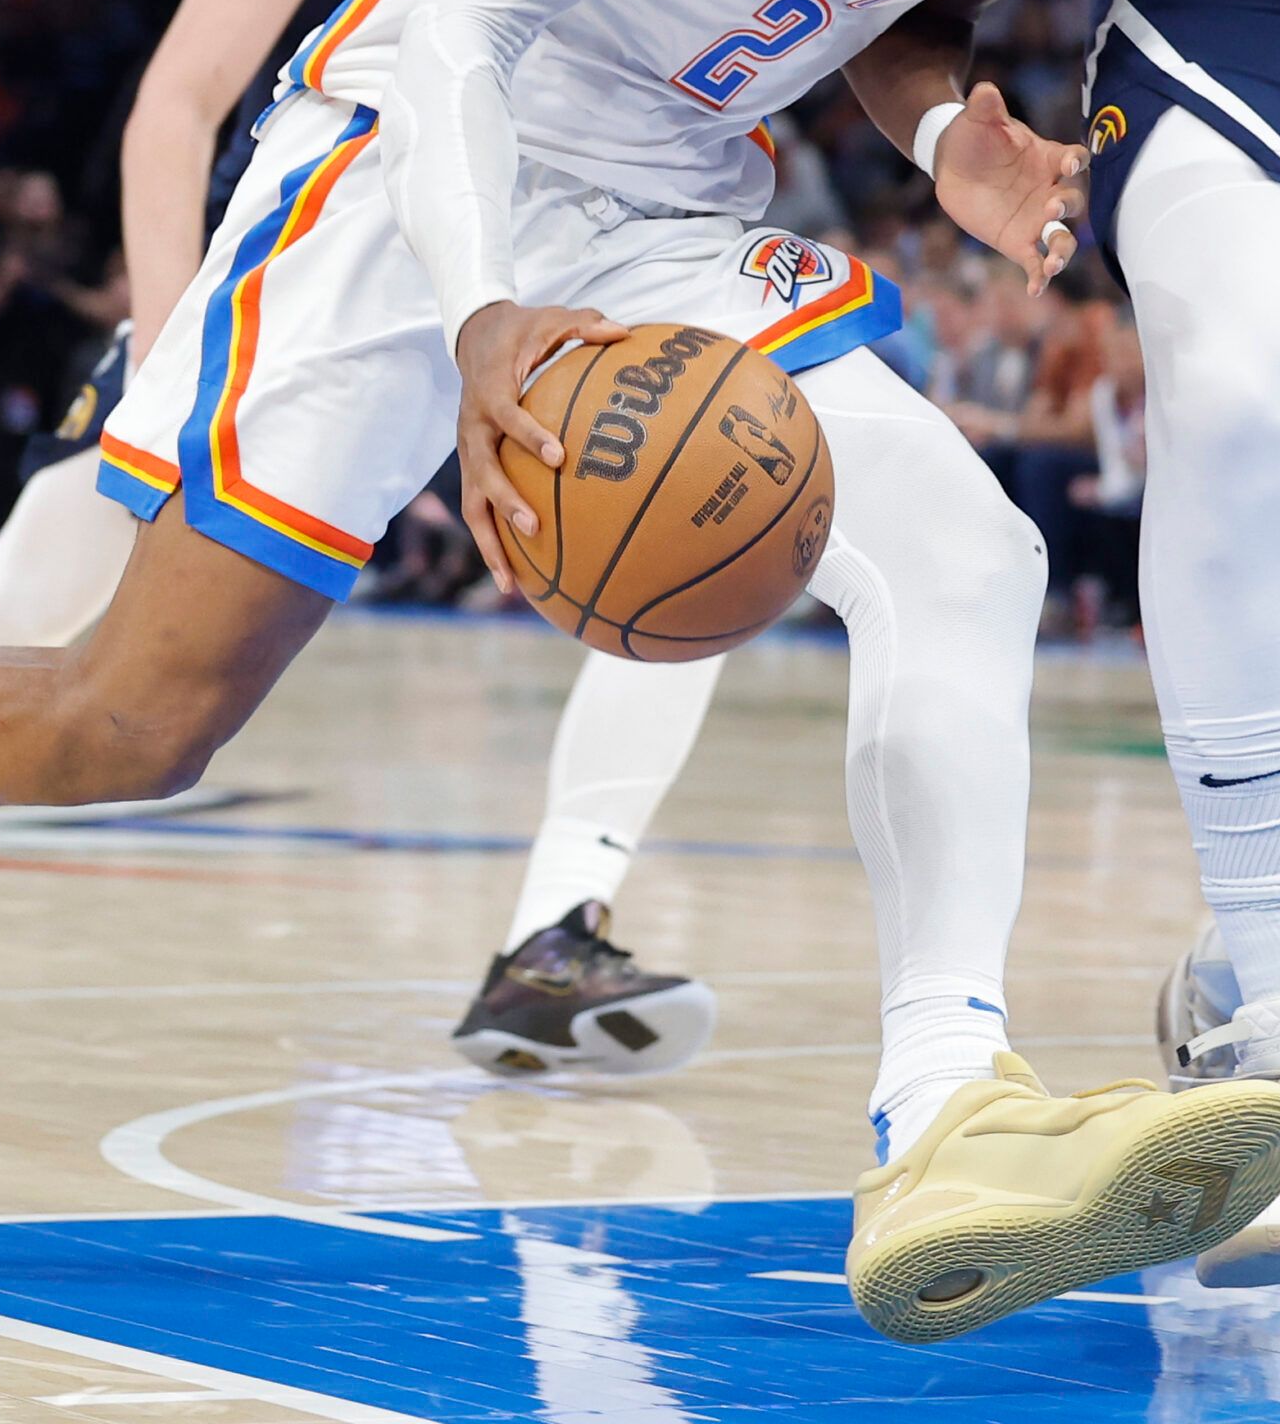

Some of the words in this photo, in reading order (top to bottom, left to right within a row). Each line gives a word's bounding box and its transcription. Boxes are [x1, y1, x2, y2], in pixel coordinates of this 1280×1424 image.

[765, 239, 804, 303] OKC
[575, 327, 727, 482] Wilson
[691, 495, 722, 528] OFFICIAL
[715, 476, 736, 500] GAME
[729, 461, 748, 482] BALL
